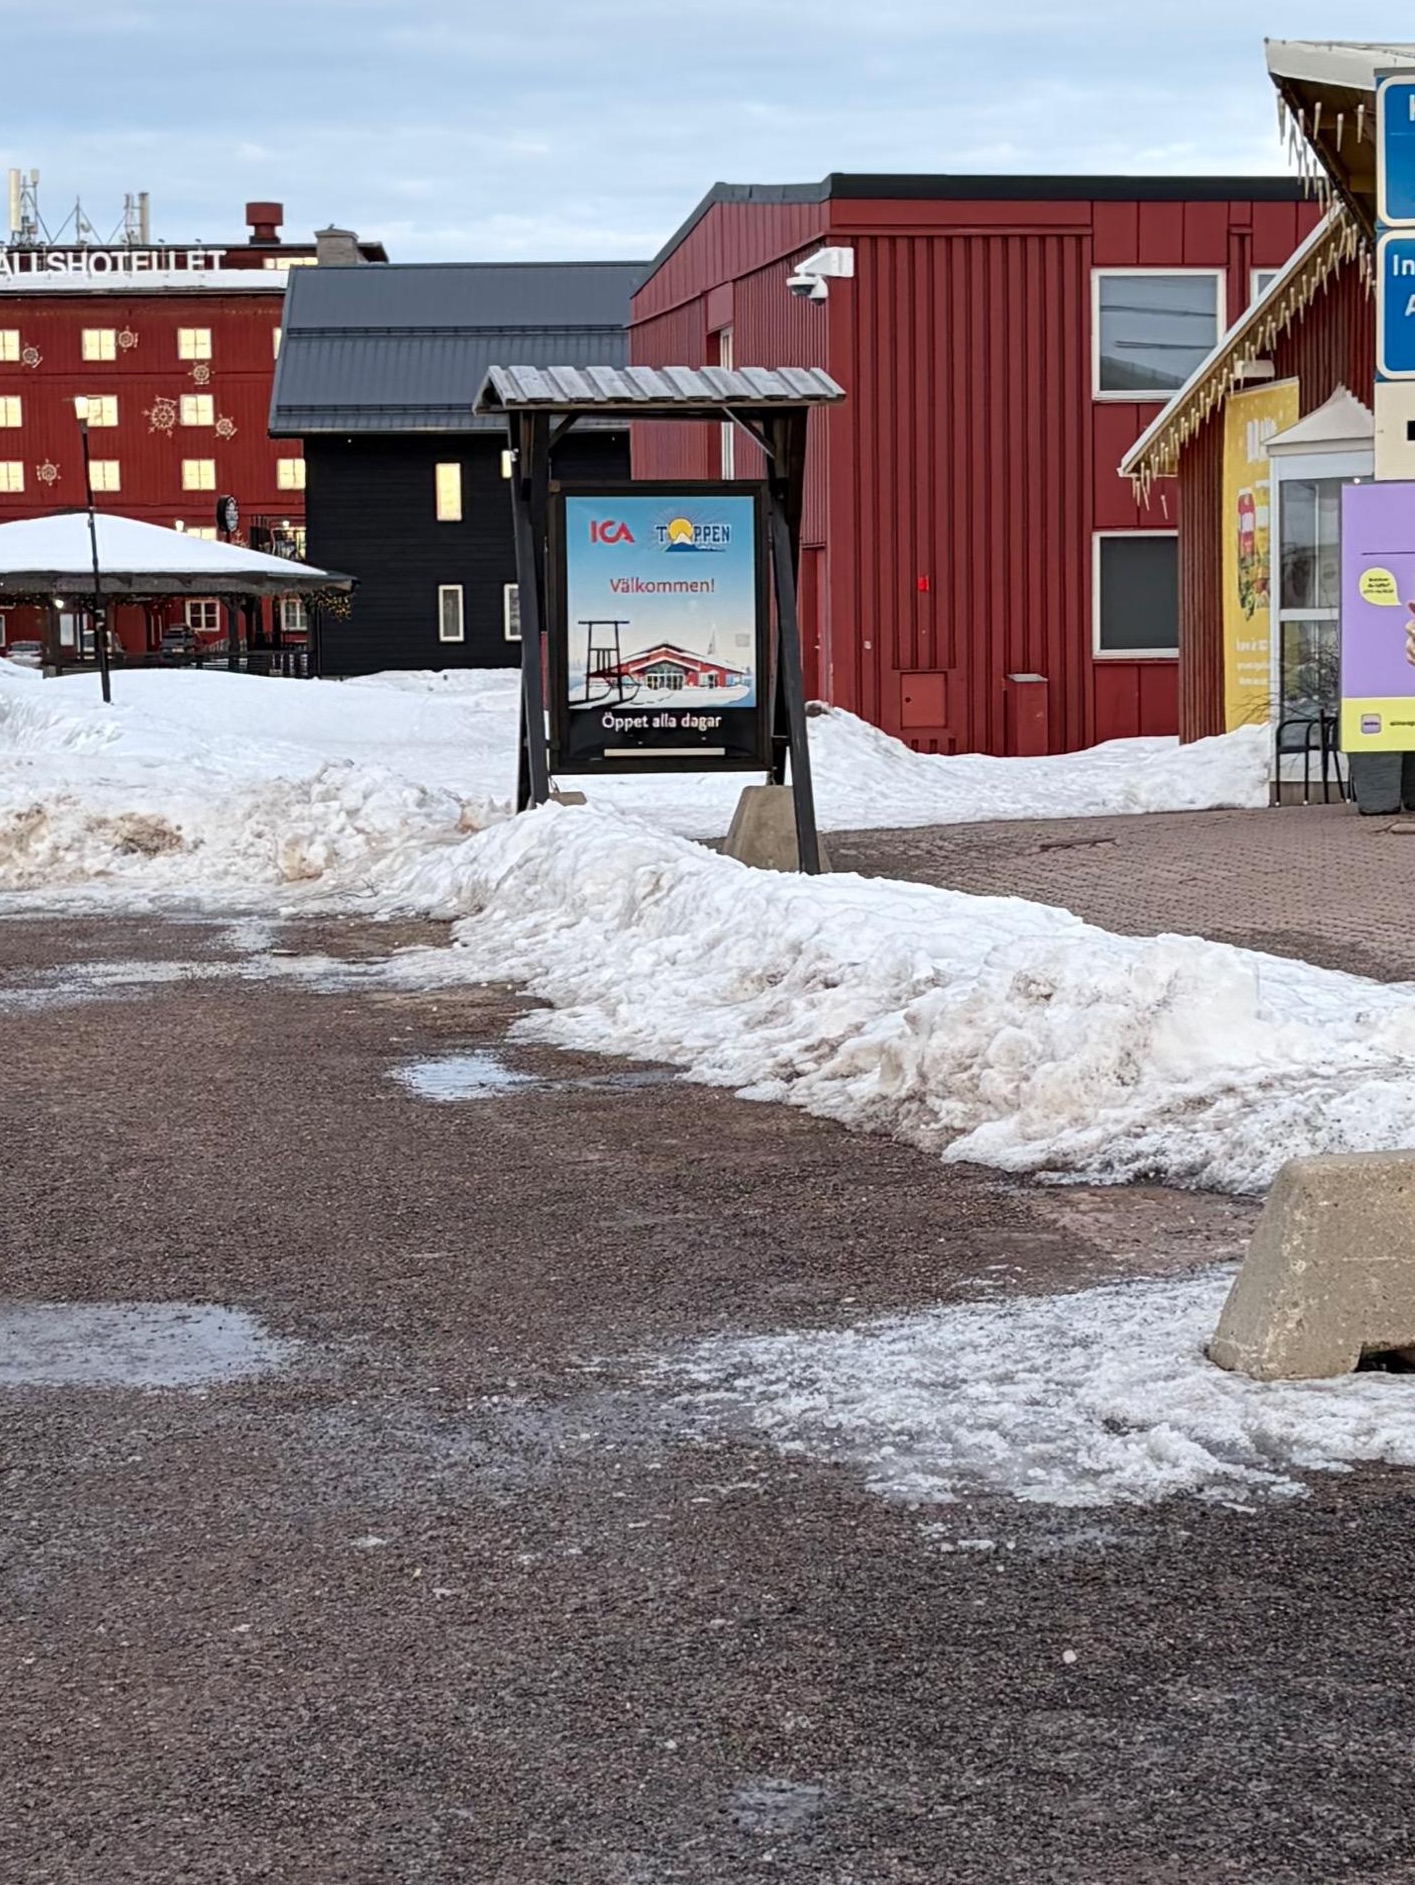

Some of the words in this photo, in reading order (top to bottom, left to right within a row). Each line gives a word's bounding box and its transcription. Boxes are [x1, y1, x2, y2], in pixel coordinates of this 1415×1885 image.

[590, 520, 635, 544] ICA
[610, 577, 715, 594] Välkommen!
[602, 711, 648, 732] Öppet
[652, 713, 677, 728] alla
[681, 713, 722, 732] dagar
